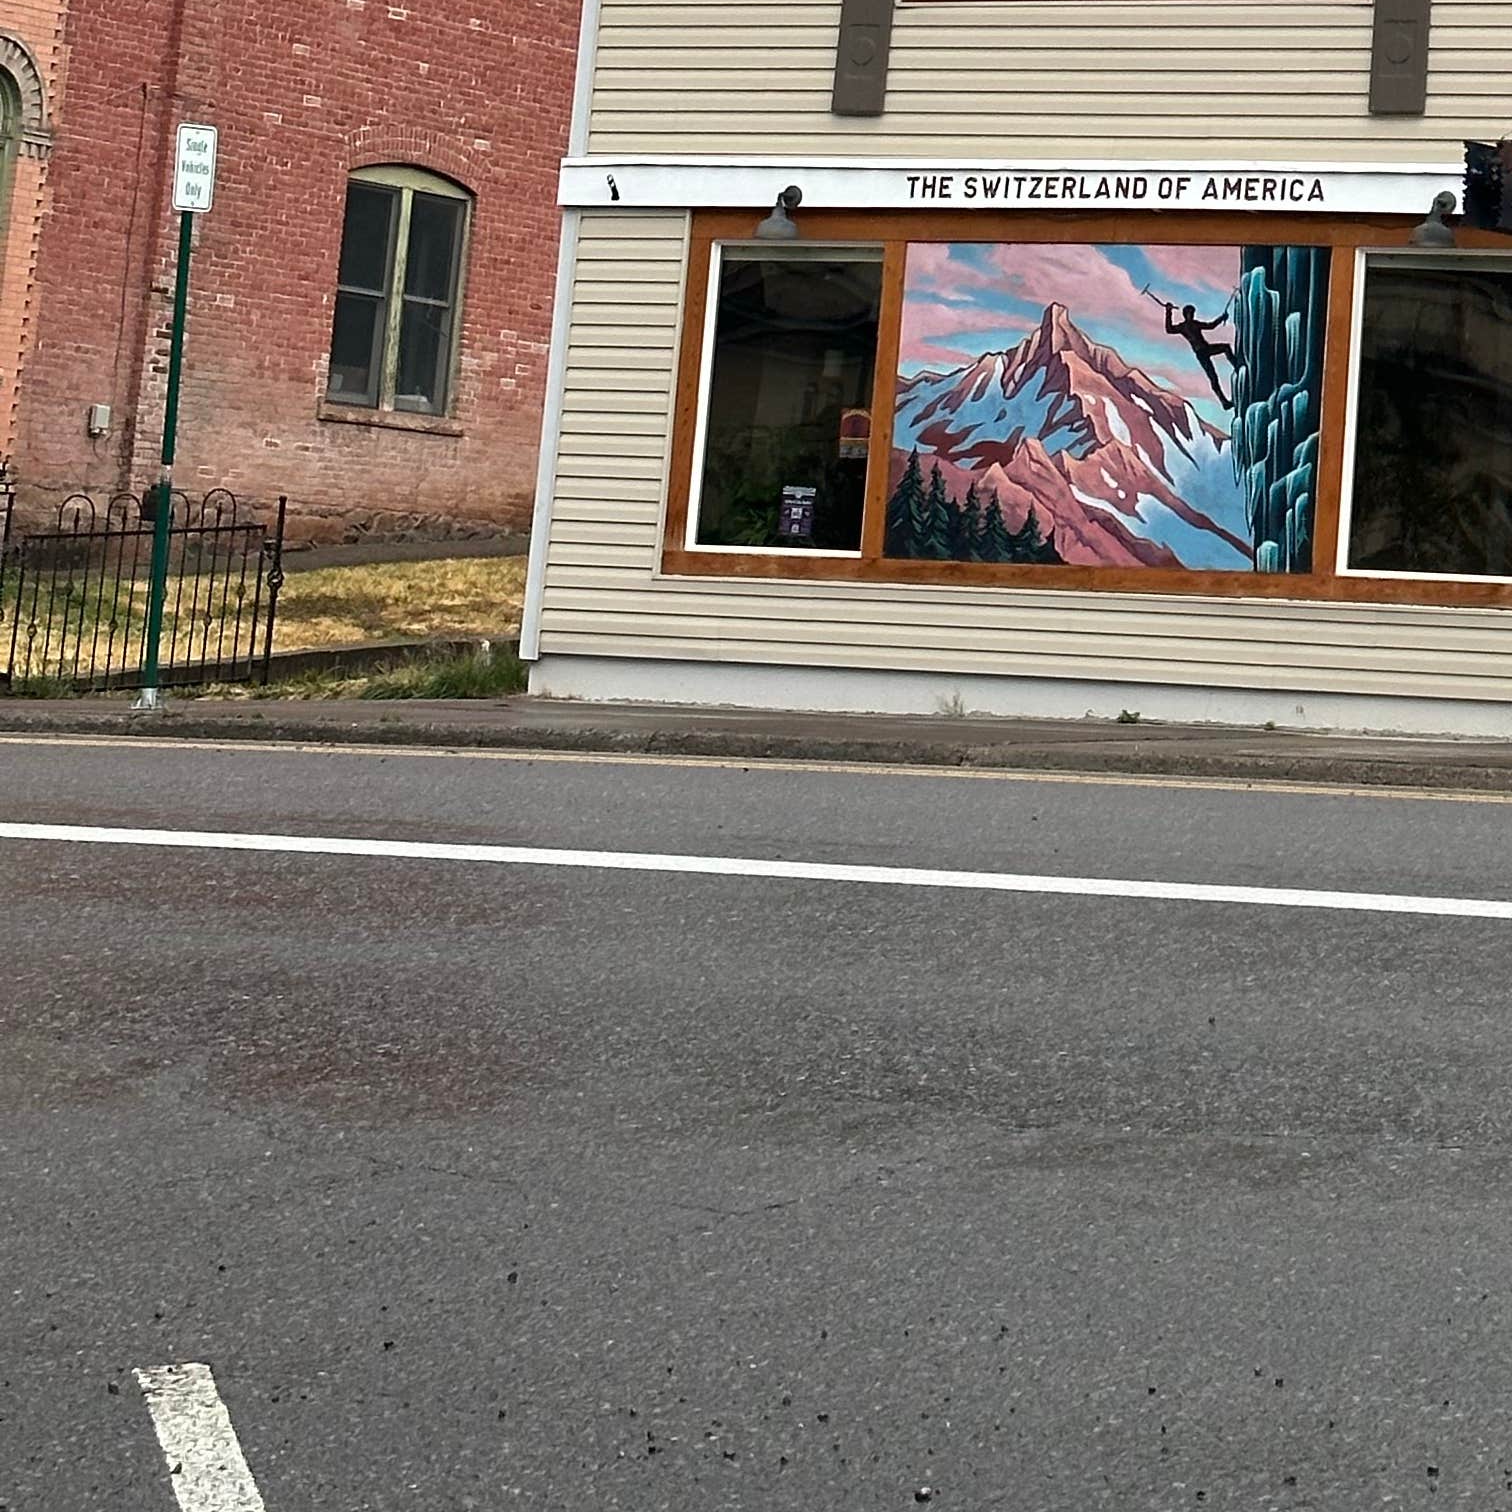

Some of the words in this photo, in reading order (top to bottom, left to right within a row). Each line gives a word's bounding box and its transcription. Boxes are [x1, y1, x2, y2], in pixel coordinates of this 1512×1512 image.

[906, 175, 954, 199] THE
[963, 175, 1148, 200] SWITZERLAND
[1157, 176, 1192, 200] OF
[1201, 177, 1325, 202] AMERICA
